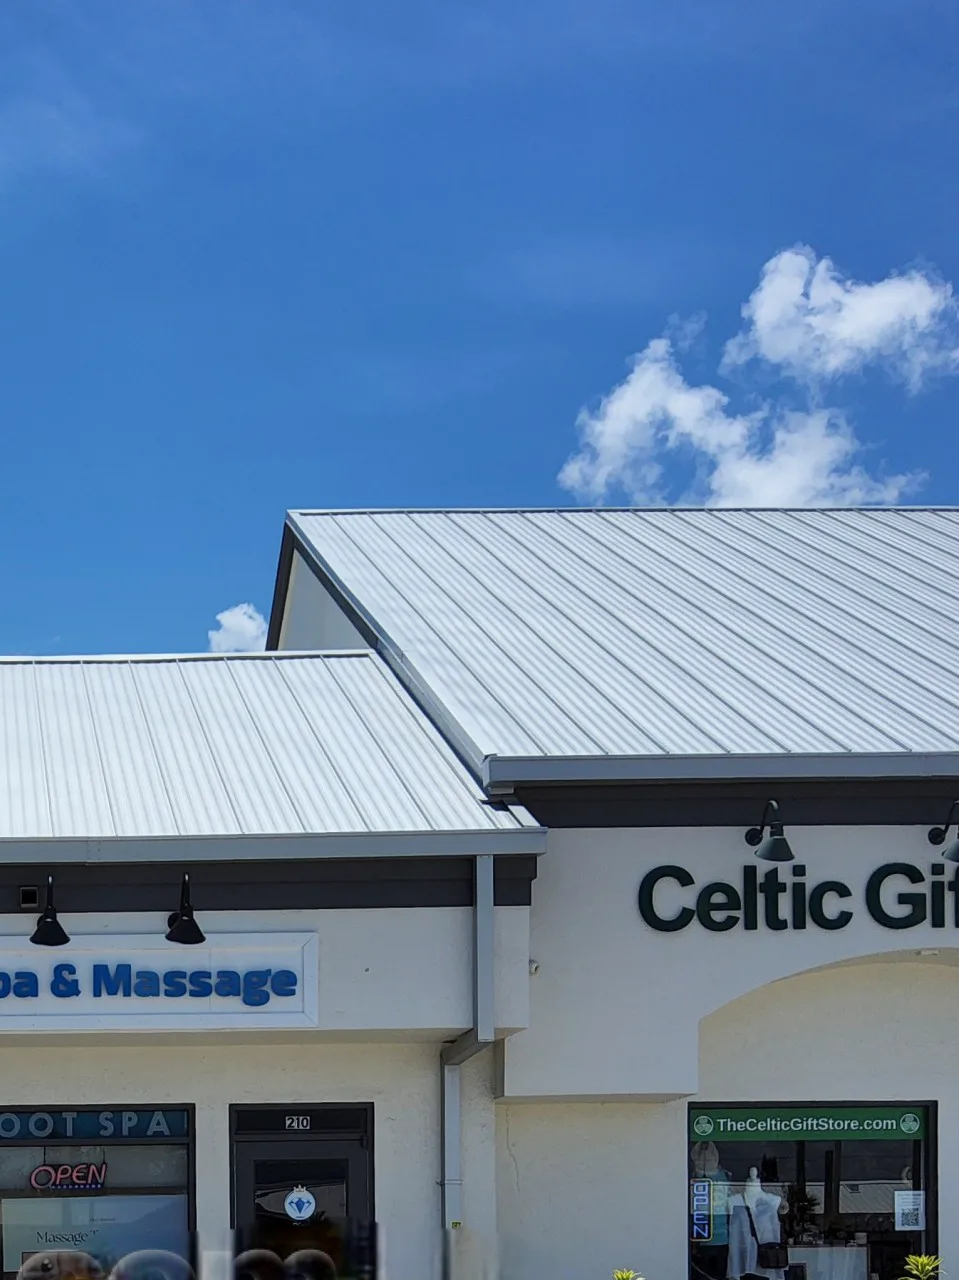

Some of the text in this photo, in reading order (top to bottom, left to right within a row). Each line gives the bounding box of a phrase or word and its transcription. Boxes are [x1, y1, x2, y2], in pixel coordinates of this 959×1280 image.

[638, 863, 854, 932] Celtic
[50, 963, 81, 998] &
[93, 963, 298, 1007] Massage
[98, 1110, 171, 1137] SPA
[286, 1116, 310, 1129] 210
[716, 1117, 897, 1132] TheCelticGiftStore.com
[30, 1163, 107, 1189] OPEN
[693, 1181, 709, 1238] OPEN
[36, 1230, 89, 1246] Massage
